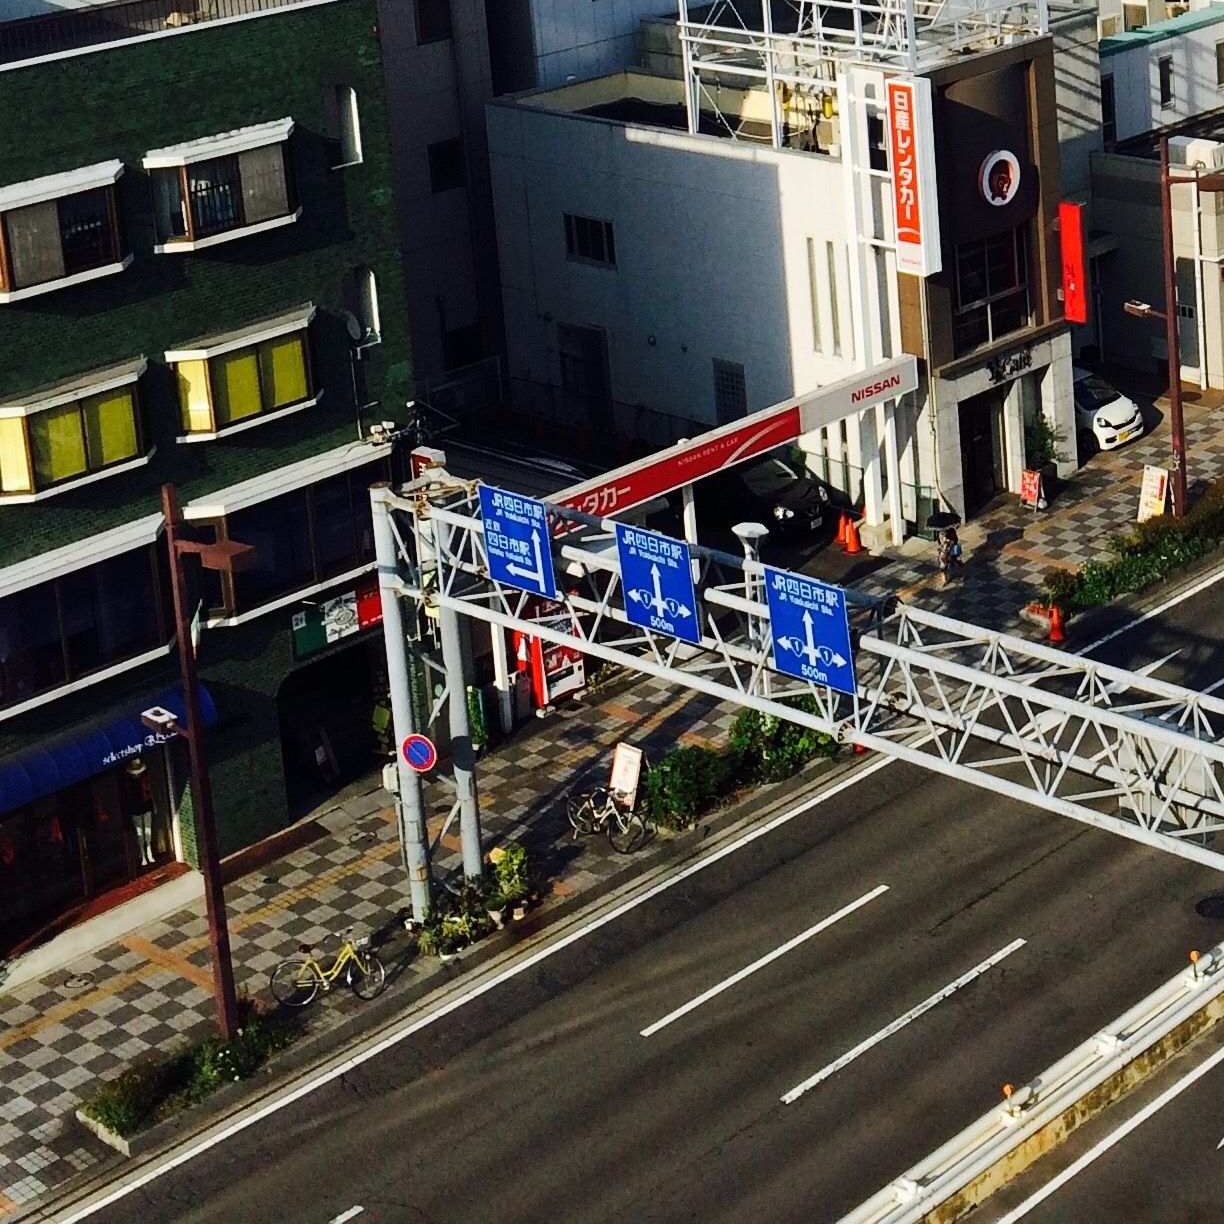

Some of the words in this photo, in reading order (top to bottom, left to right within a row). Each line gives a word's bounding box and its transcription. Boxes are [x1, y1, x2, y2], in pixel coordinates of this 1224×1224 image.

[893, 90, 915, 220] 日産レンタカー
[851, 374, 901, 403] NISSAN
[492, 492, 544, 520] JR四日市駅
[487, 531, 531, 556] 四日市駅
[621, 530, 684, 560] JR四日市駅
[772, 574, 840, 608] JR四日市駅
[650, 615, 675, 633] 500m
[801, 664, 828, 682] 500m
